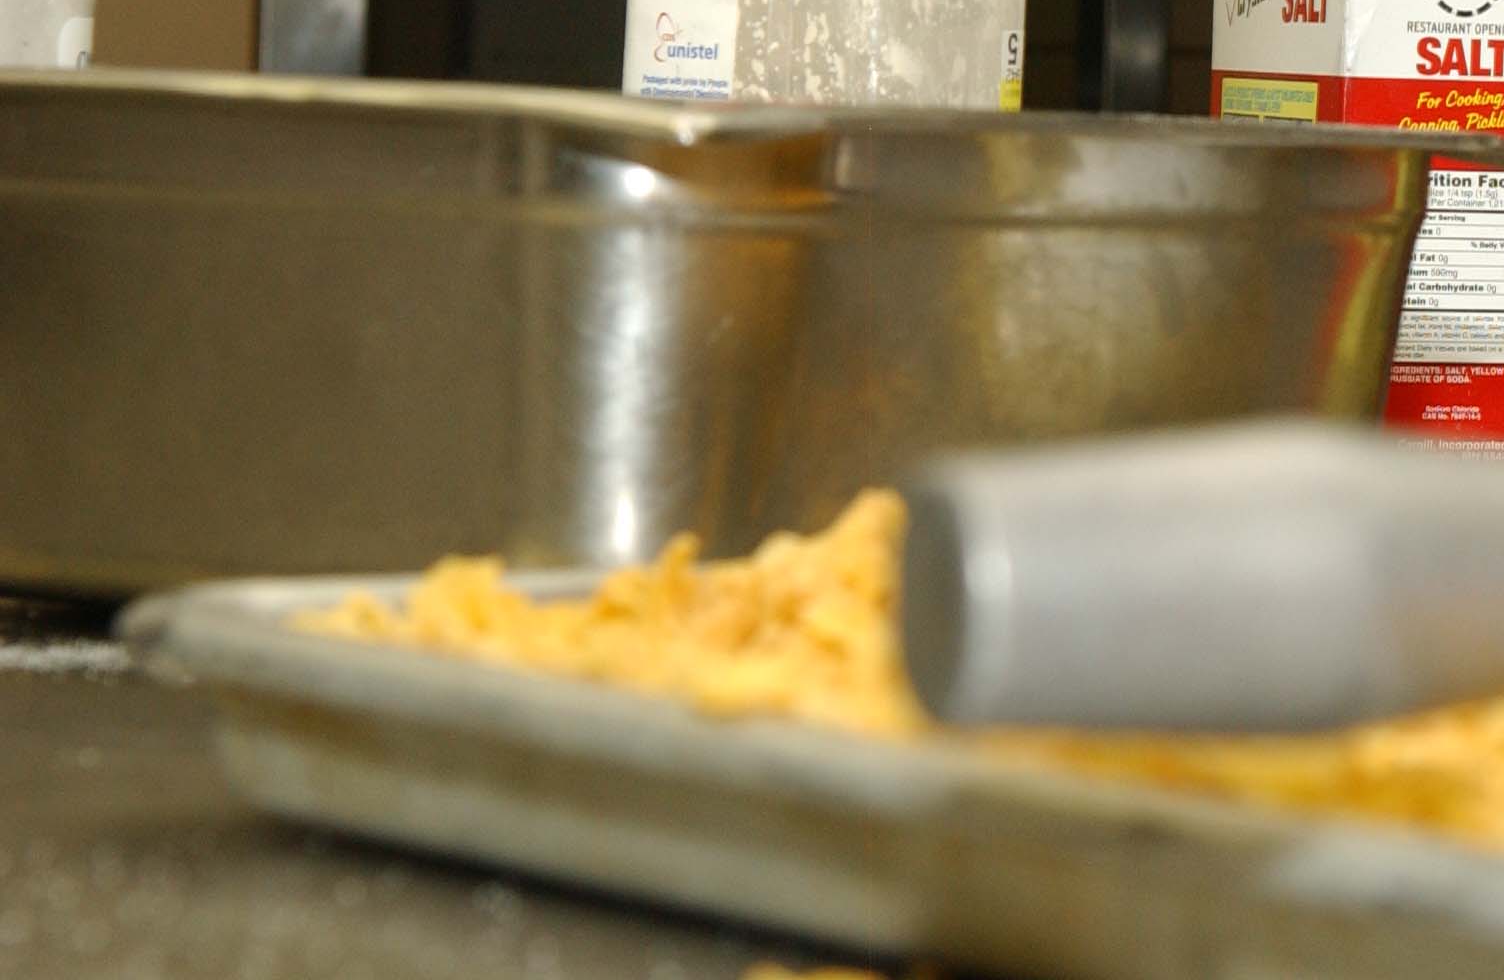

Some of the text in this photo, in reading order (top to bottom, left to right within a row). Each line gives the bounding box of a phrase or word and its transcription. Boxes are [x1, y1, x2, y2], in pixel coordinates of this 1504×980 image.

[1407, 21, 1472, 34] RESTAURANT
[666, 42, 719, 60] unistel
[1416, 92, 1442, 110] For
[1447, 199, 1486, 208] Container
[1438, 214, 1466, 223] Serving
[1420, 254, 1436, 263] Fat
[1438, 254, 1449, 264] 0g
[1418, 283, 1484, 294] Carbohydrate
[1486, 284, 1497, 295] 0g
[1428, 298, 1439, 308] 0g
[1444, 366, 1468, 376] SALT,
[1471, 367, 1504, 377] YELLOW
[1433, 375, 1445, 383] OF
